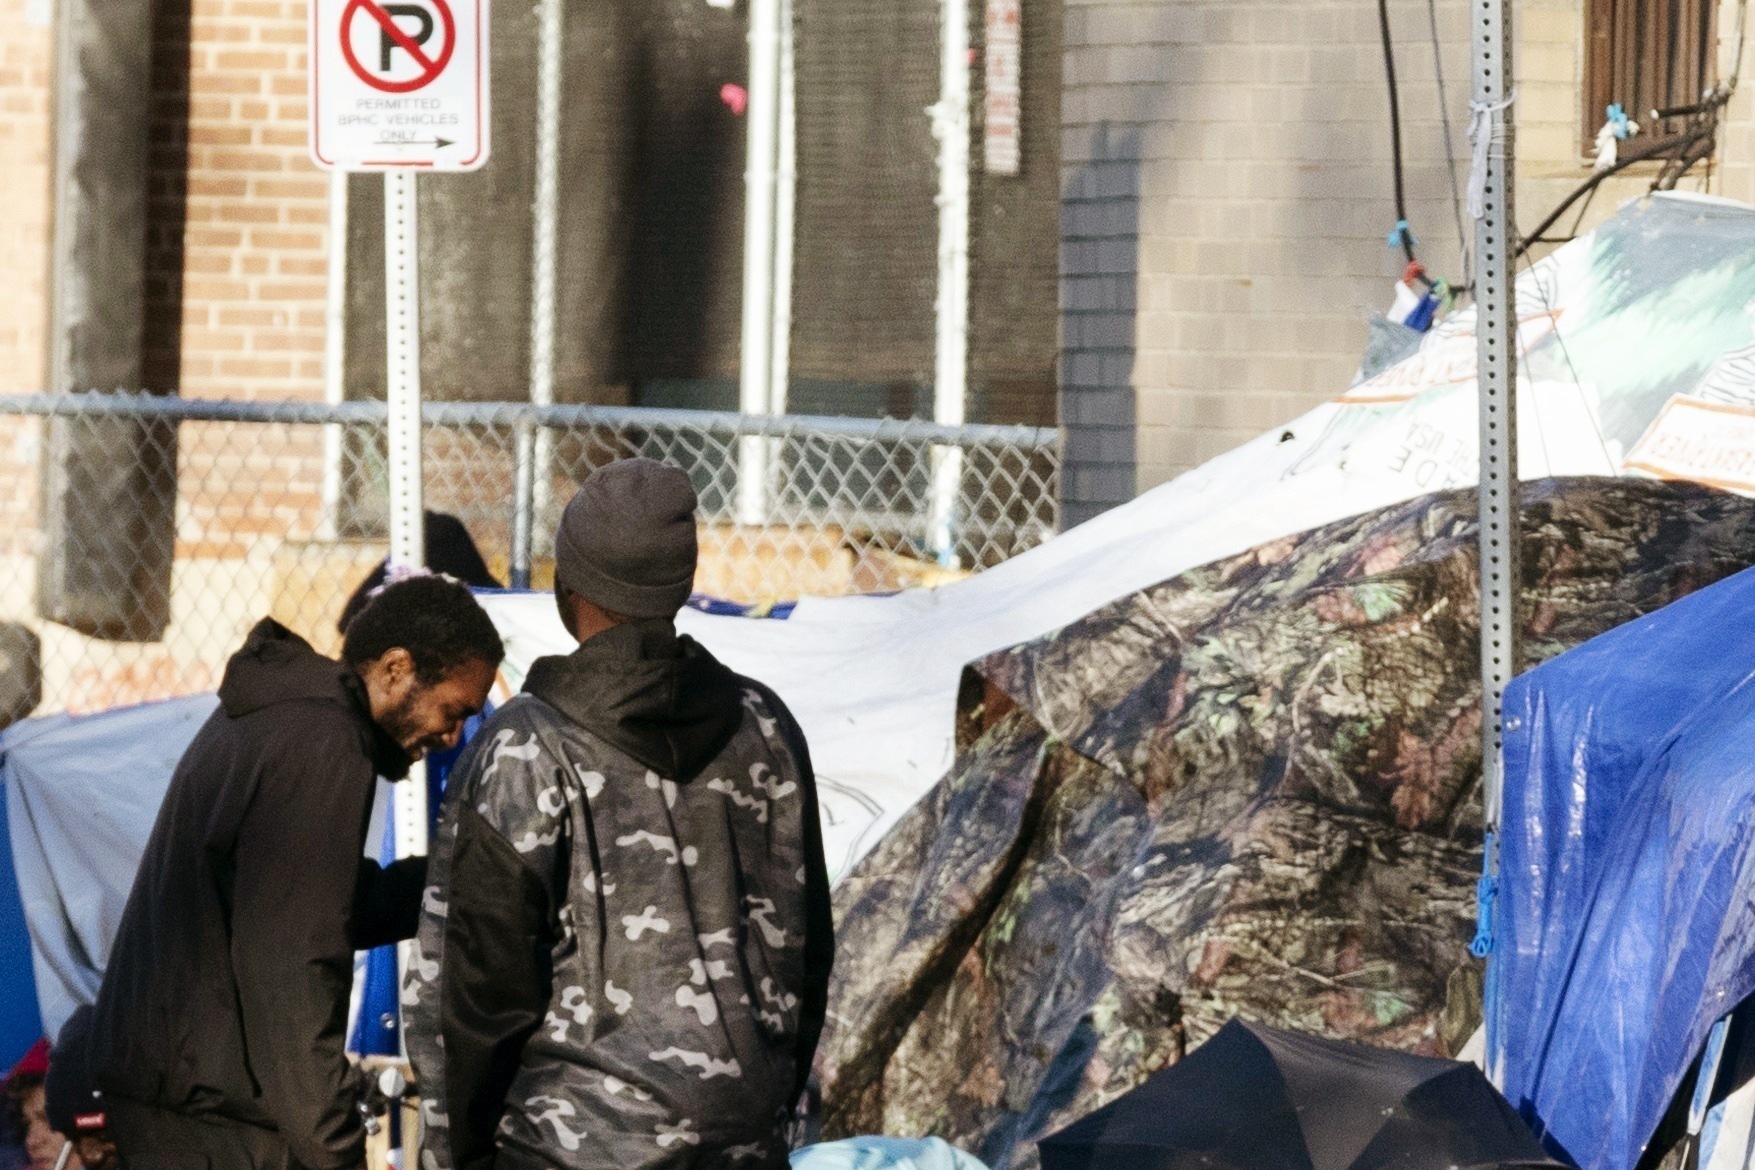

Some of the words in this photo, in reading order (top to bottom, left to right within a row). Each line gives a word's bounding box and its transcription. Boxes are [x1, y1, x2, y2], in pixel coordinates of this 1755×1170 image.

[356, 98, 441, 110] PERMITTED
[338, 114, 378, 126] BPHC
[386, 113, 459, 126] VEHICLES
[380, 130, 417, 141] ONLY
